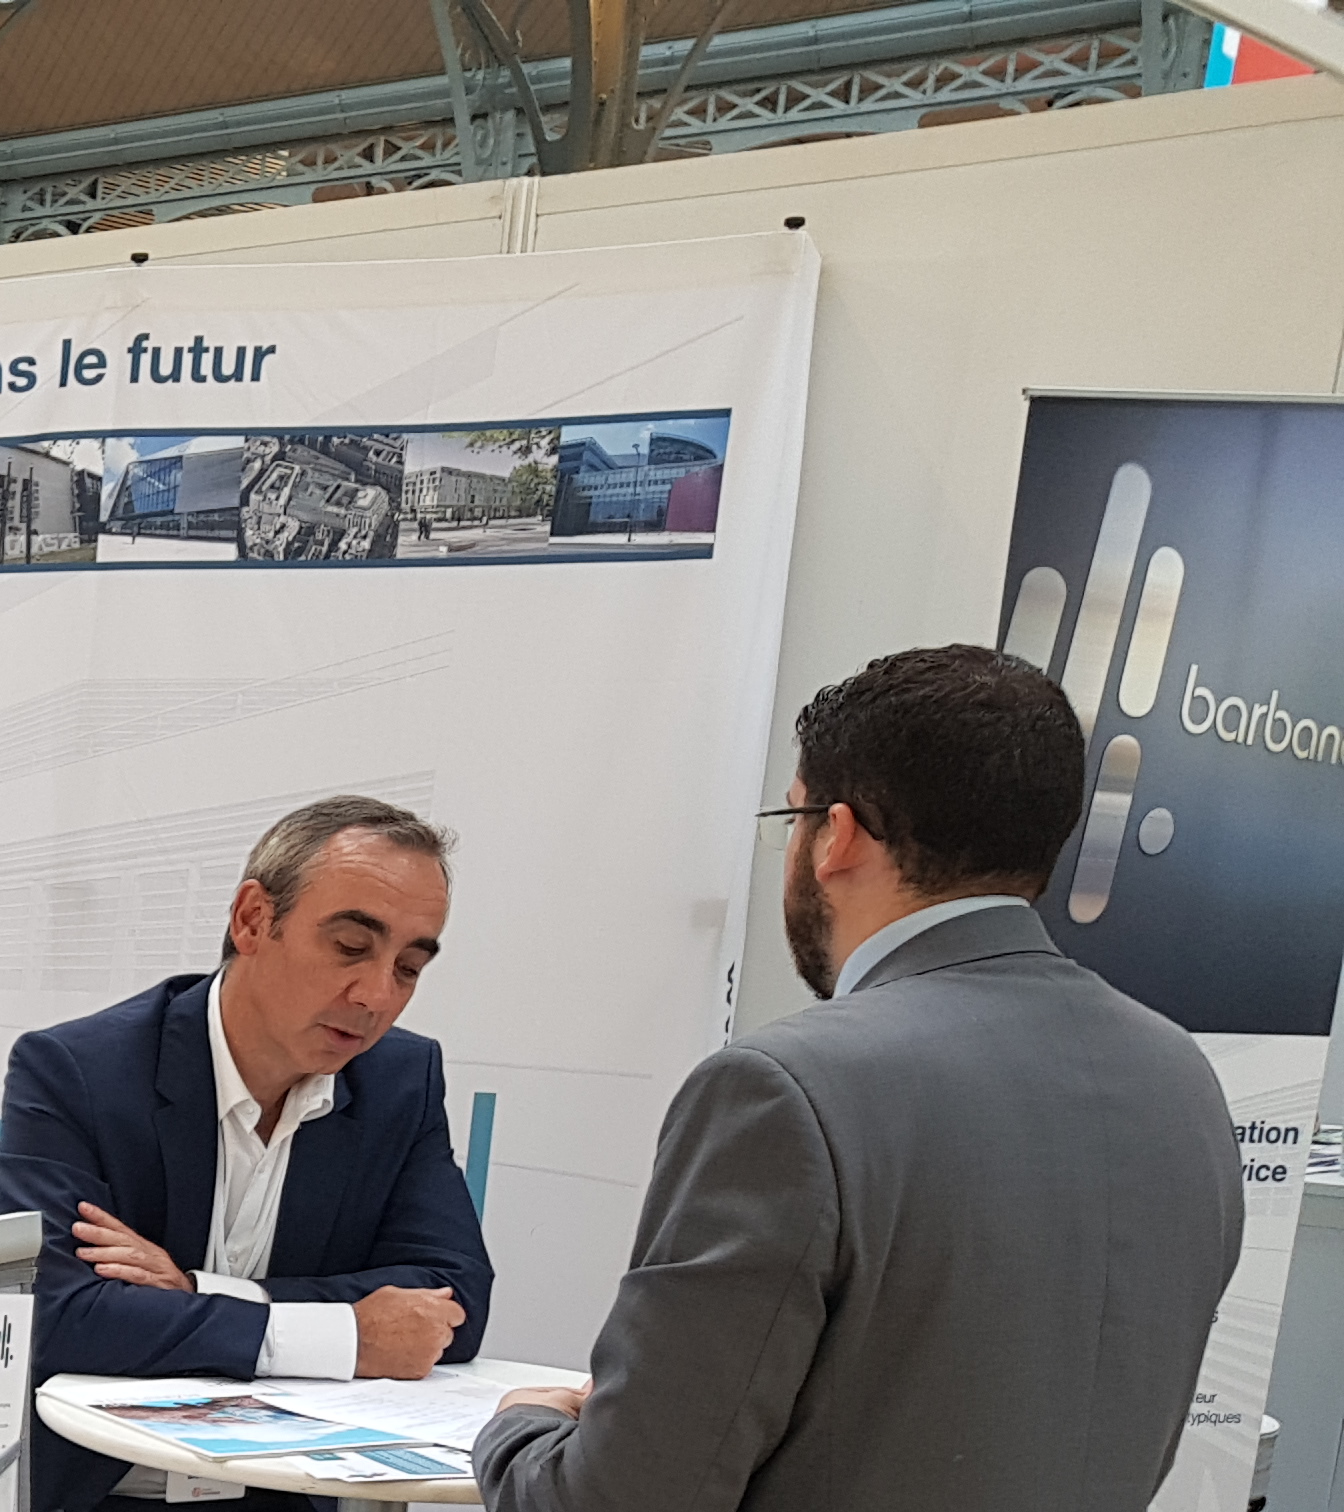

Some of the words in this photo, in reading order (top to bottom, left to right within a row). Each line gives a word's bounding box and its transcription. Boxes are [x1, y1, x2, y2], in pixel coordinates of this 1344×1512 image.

[58, 338, 107, 388] le
[128, 332, 277, 385] futur
[1180, 662, 1344, 764] barban
[1234, 1121, 1299, 1145] ation
[1195, 1393, 1217, 1404] eur
[1187, 1410, 1242, 1427] ypiques
